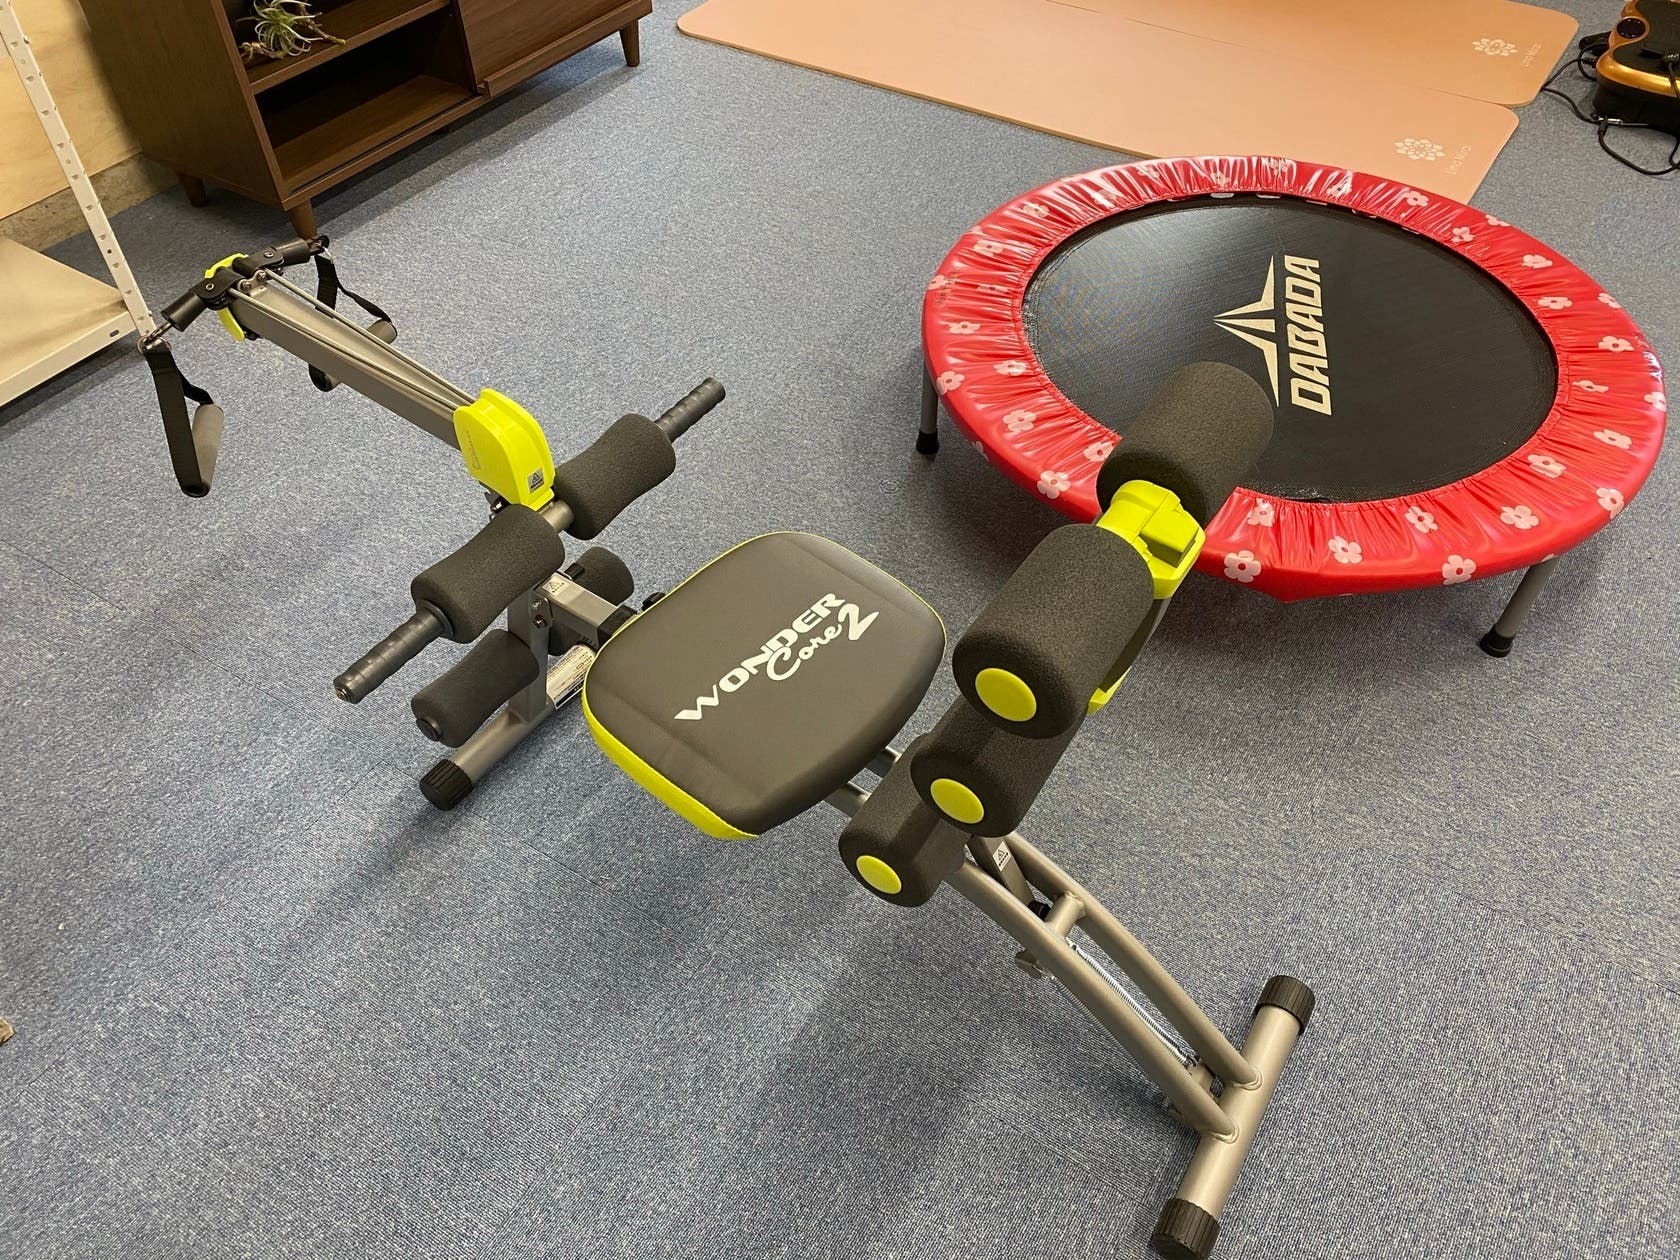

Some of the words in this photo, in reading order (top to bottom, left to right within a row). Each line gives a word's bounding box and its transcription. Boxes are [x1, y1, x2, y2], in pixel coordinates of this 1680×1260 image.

[1284, 254, 1332, 416] DABADA
[673, 593, 846, 720] WONDER
[766, 623, 842, 681] Core
